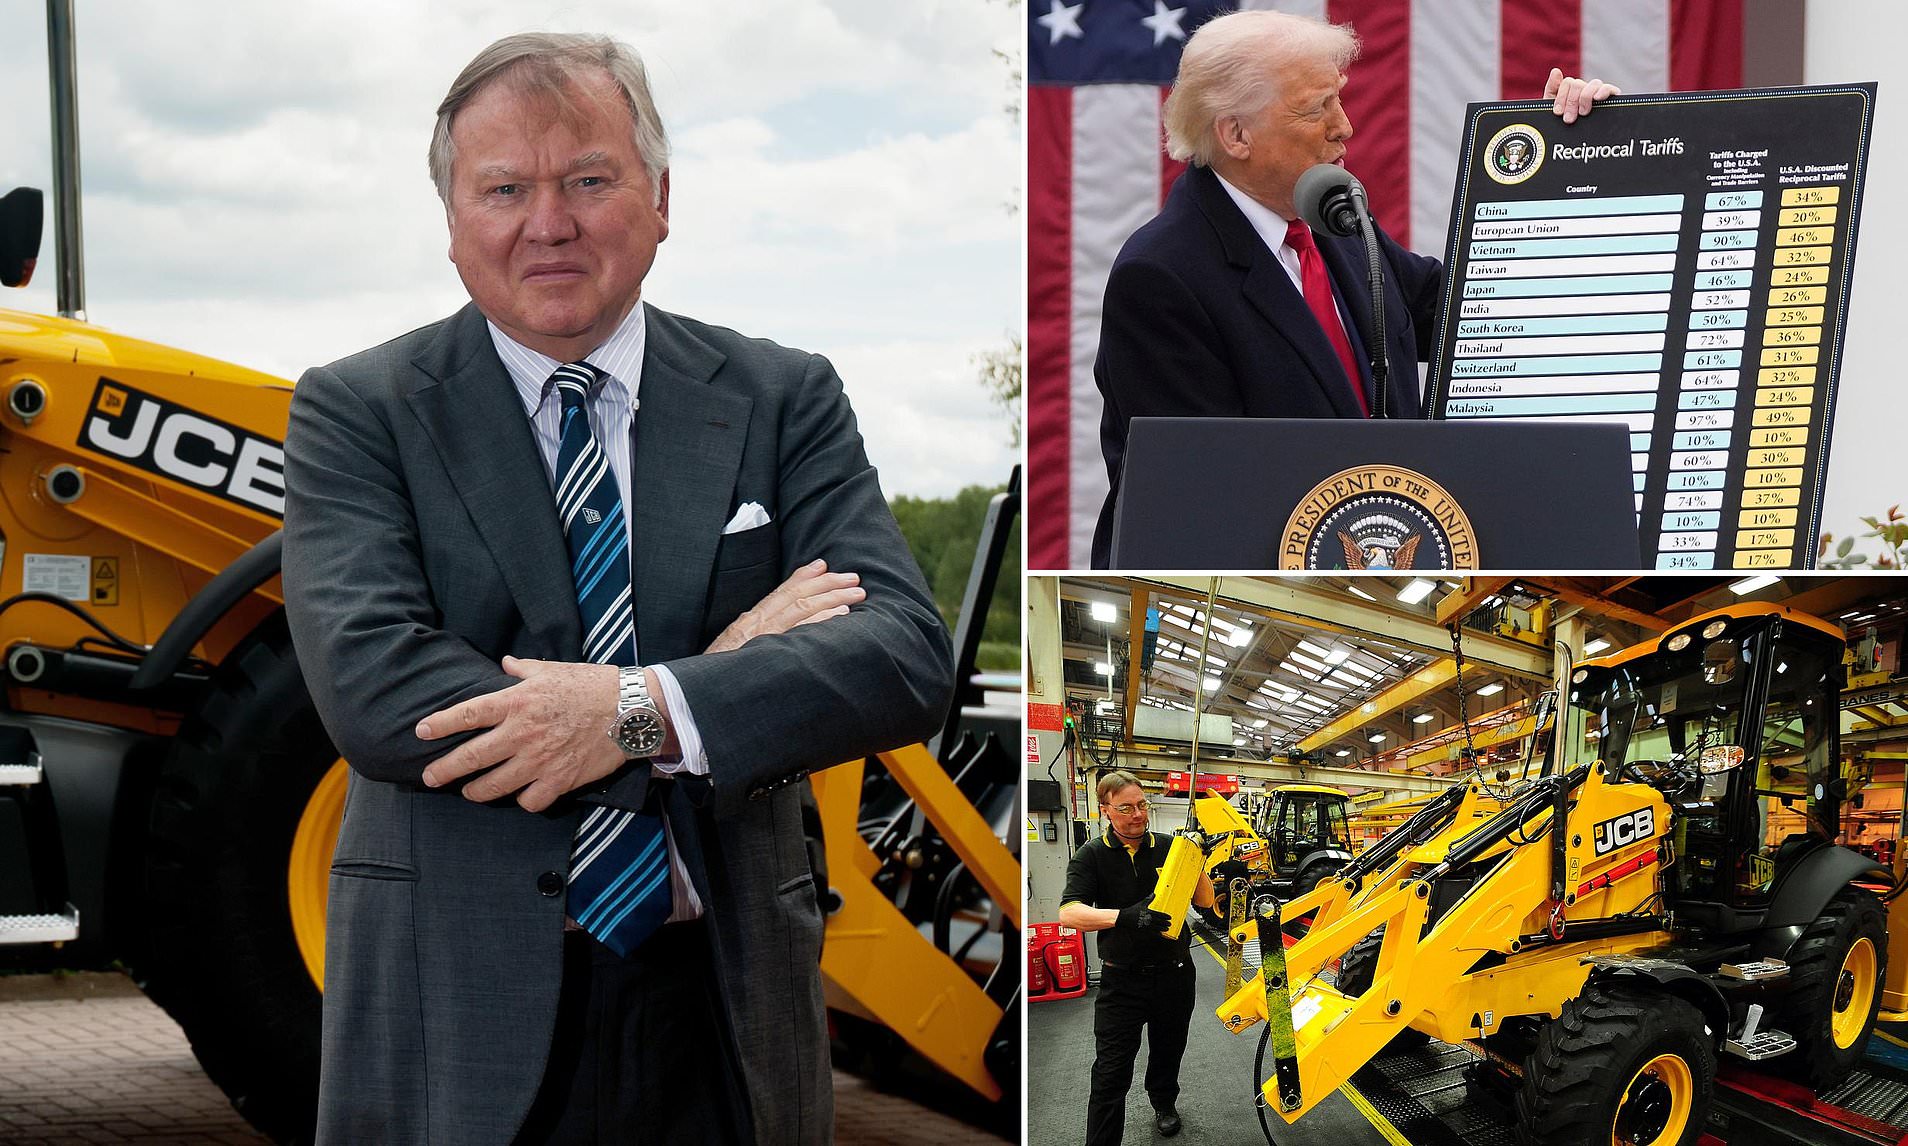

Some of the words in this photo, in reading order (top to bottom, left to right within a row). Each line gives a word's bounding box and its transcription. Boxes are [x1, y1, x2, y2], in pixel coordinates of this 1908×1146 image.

[1552, 138, 1634, 163] Reciprocal
[1640, 137, 1685, 156] Tariffs
[1709, 150, 1734, 159] Tariffs
[1735, 149, 1768, 159] Charged
[1713, 160, 1722, 168] to
[1723, 160, 1737, 168] the
[1738, 159, 1761, 167] U.S.A.
[1779, 165, 1803, 174] U.S.A.
[1804, 162, 1849, 173] Discounted
[1779, 173, 1821, 184] Reciprocal
[1821, 171, 1847, 181] Tariffs
[1566, 184, 1598, 194] Country
[1718, 196, 1746, 206] 67%
[1795, 192, 1823, 203] 34%
[1477, 206, 1508, 217] China
[1793, 212, 1820, 222] 20%
[1717, 216, 1744, 226] 39%
[1474, 226, 1524, 238] European
[1527, 223, 1560, 234] Union
[1714, 236, 1742, 246] 90%
[1790, 232, 1818, 242] 46%
[1472, 245, 1516, 255] Vietnam
[1710, 256, 1738, 266] 64%
[1787, 251, 1815, 263] 32%
[1469, 264, 1507, 275] Taiwan
[1708, 275, 1736, 286] 46%
[1785, 272, 1812, 282] 24%
[1465, 285, 1495, 297] Japan
[1782, 291, 1810, 302] 26%
[1706, 295, 1734, 305] 52%
[1463, 303, 1490, 314] India
[1702, 314, 1731, 326] 50%
[1780, 311, 1808, 322] 25%
[1459, 323, 1490, 334] South
[1493, 323, 1524, 333] Korea
[1702, 335, 1728, 345] 72%
[1777, 331, 1805, 342] 36%
[1457, 342, 1503, 354] Thailand
[1697, 355, 1726, 366] 61%
[1774, 351, 1802, 362] 31%
[1453, 361, 1517, 374] Switzerland
[1694, 375, 1722, 386] 64%
[1771, 372, 1800, 382] 32%
[1451, 382, 1502, 394] Indonesia
[1692, 394, 1720, 406] 47%
[1769, 392, 1797, 402] 24%
[1447, 402, 1495, 416] Malaysia
[1690, 416, 1717, 425] 97%
[1766, 412, 1794, 422] 49%
[1688, 435, 1714, 446] 10%
[1765, 432, 1792, 443] 10%
[88, 399, 285, 514] JCB
[1684, 456, 1712, 466] 60%
[1760, 452, 1789, 464] 30%
[1682, 476, 1709, 486] 10%
[1760, 472, 1786, 484] 10%
[1680, 496, 1706, 506] 74%
[1755, 493, 1784, 504] 37%
[1286, 472, 1377, 557] PRESIDENT
[1383, 475, 1401, 487] OF
[1405, 479, 1430, 500] THE
[1754, 514, 1780, 524] 10%
[1677, 516, 1704, 527] 10%
[1673, 537, 1700, 547] 33%
[1752, 533, 1778, 545] 17%
[1669, 556, 1698, 568] 34%
[1749, 554, 1775, 566] 17%
[1596, 809, 1654, 853] JCB
[1238, 841, 1259, 852] CB
[1752, 858, 1773, 886] JCB
